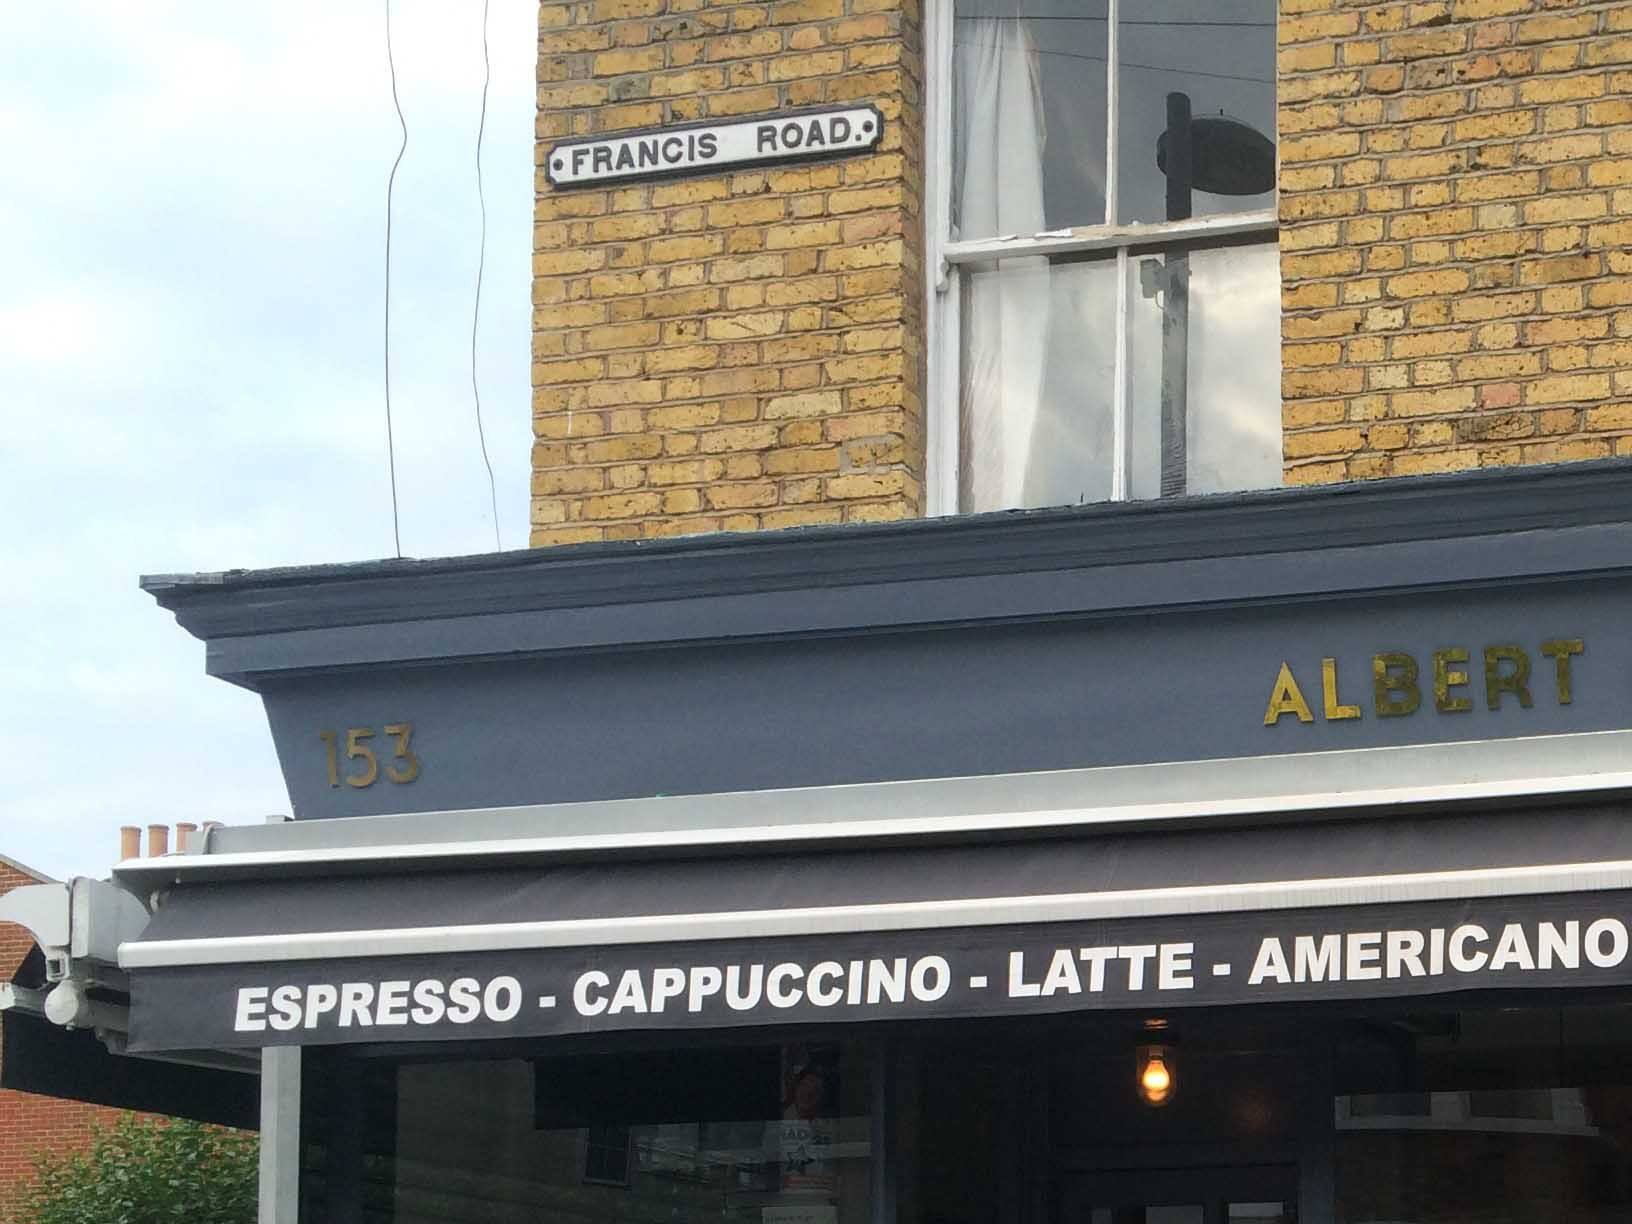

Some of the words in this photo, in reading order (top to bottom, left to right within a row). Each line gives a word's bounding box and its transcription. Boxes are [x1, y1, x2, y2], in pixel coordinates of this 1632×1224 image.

[571, 132, 718, 175] FRANCIS
[757, 116, 863, 153] ROAD.
[1264, 638, 1585, 726] ALBERT
[320, 720, 419, 788] 153
[233, 975, 523, 1032] ESPRESSO
[572, 955, 951, 1017] CAPPUCCINO
[1008, 942, 1194, 998] LATTE
[1247, 918, 1629, 985] AMERICANO
